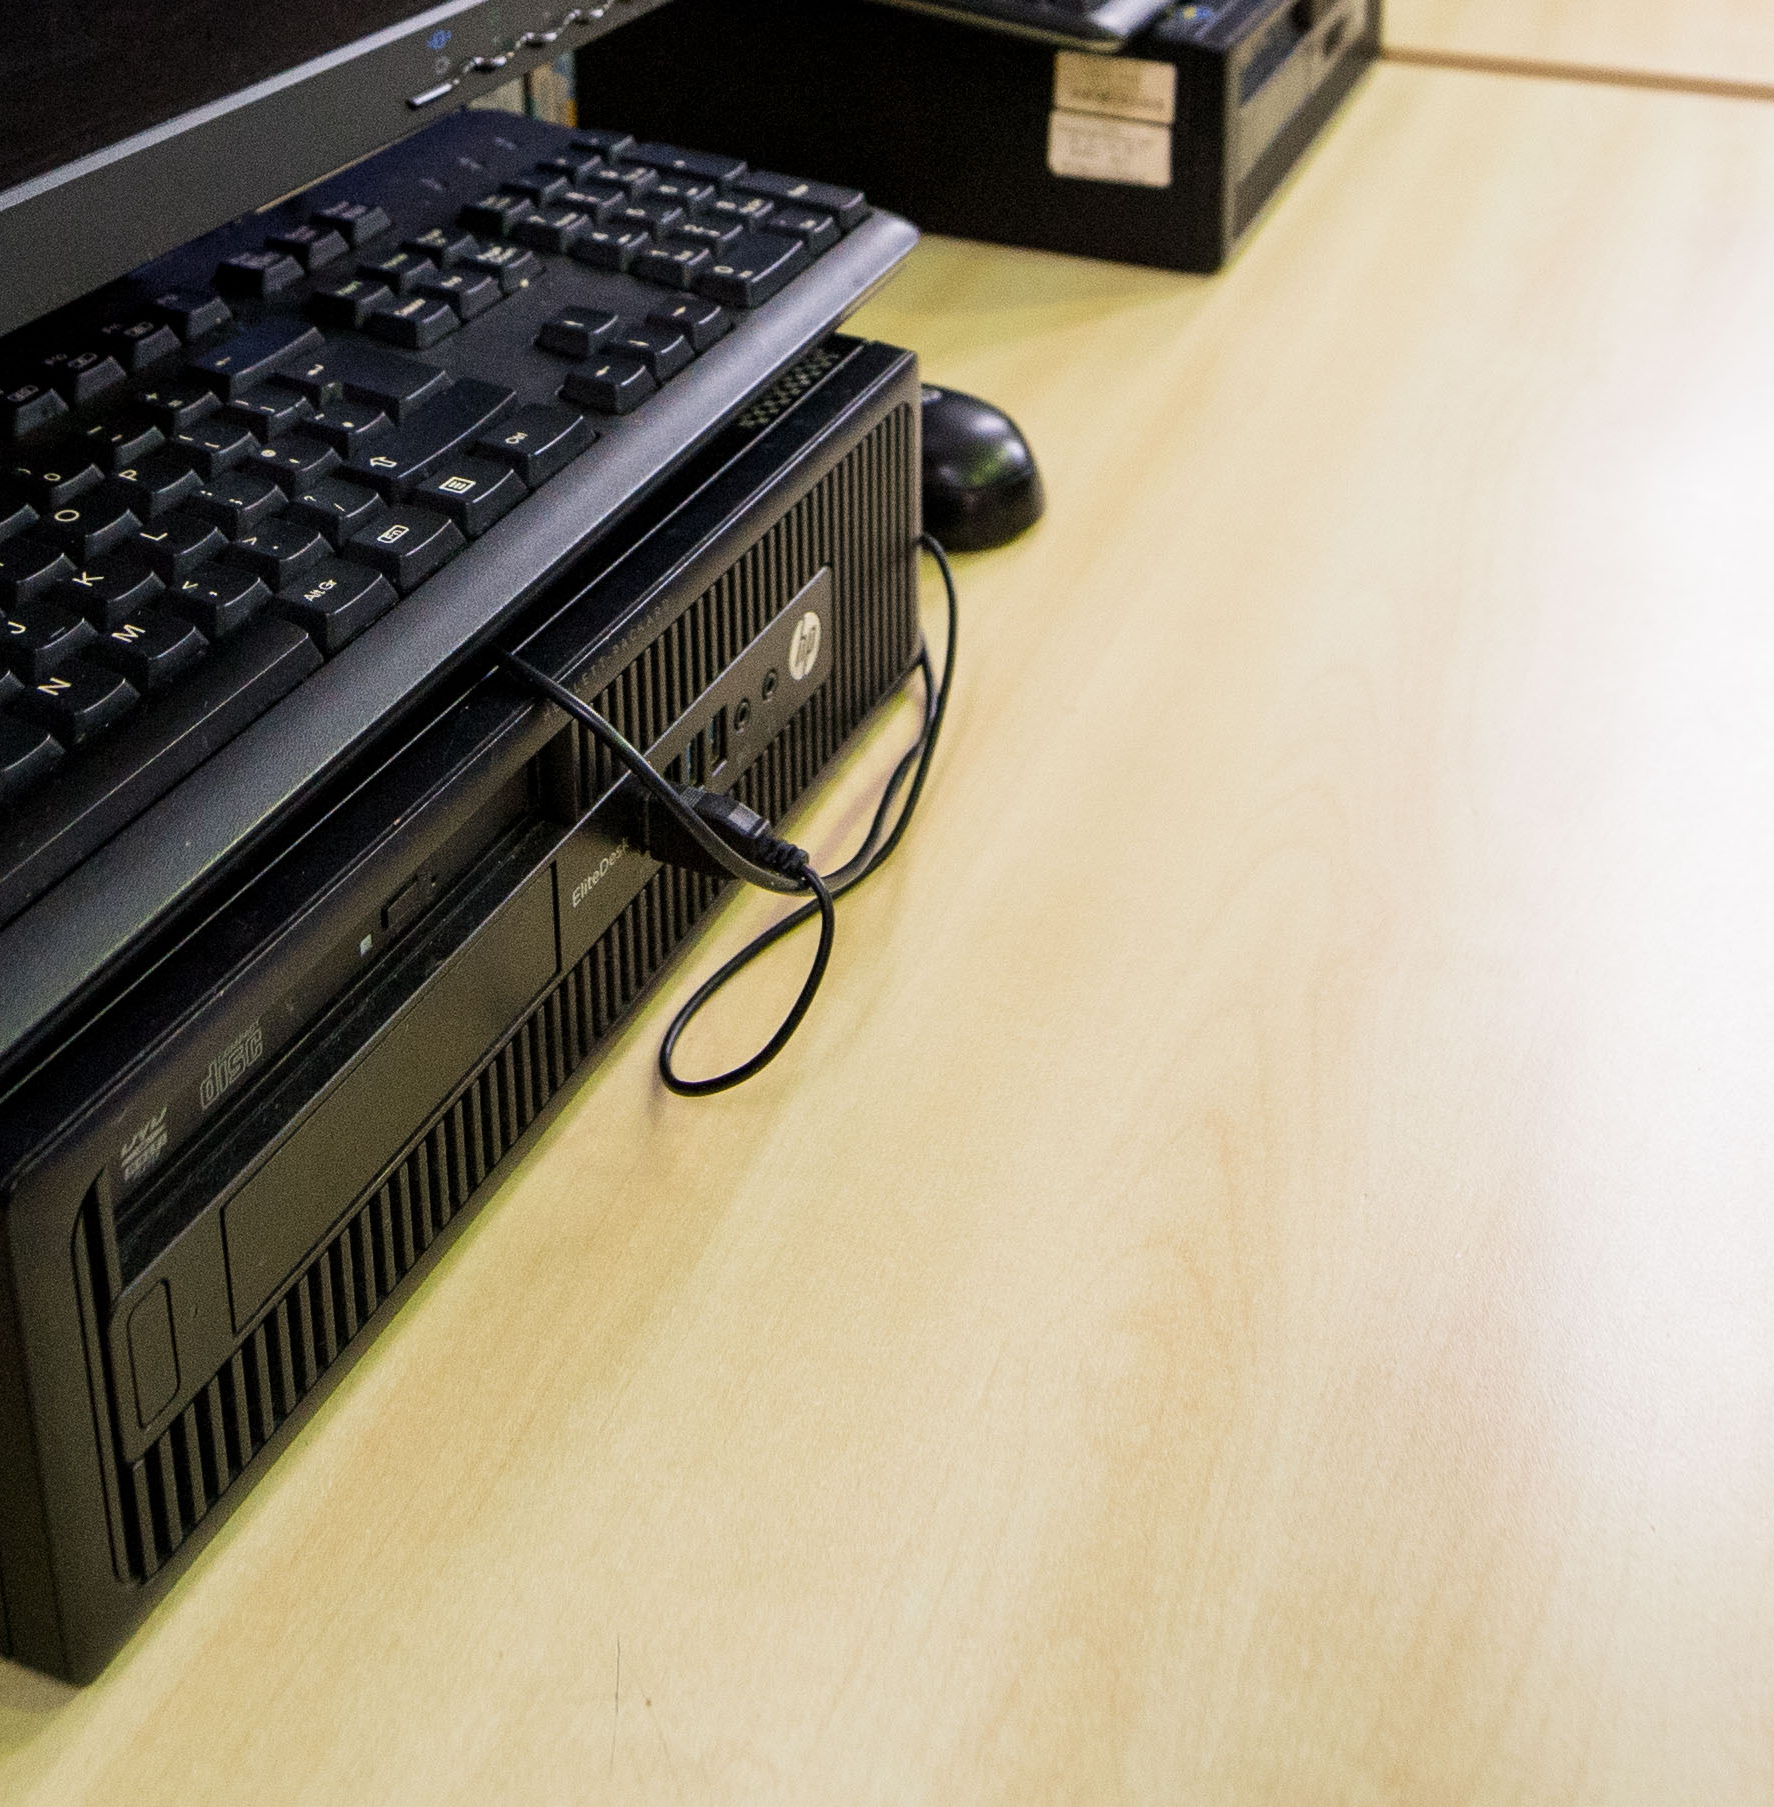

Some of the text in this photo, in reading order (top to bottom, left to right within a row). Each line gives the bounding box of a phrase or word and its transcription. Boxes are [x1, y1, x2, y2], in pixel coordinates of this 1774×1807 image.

[43, 472, 62, 482] 0
[118, 469, 138, 482] P
[53, 509, 80, 523] O
[139, 532, 168, 542] L
[72, 571, 104, 587] K
[7, 620, 27, 635] J
[111, 624, 145, 643] M
[37, 677, 71, 696] N
